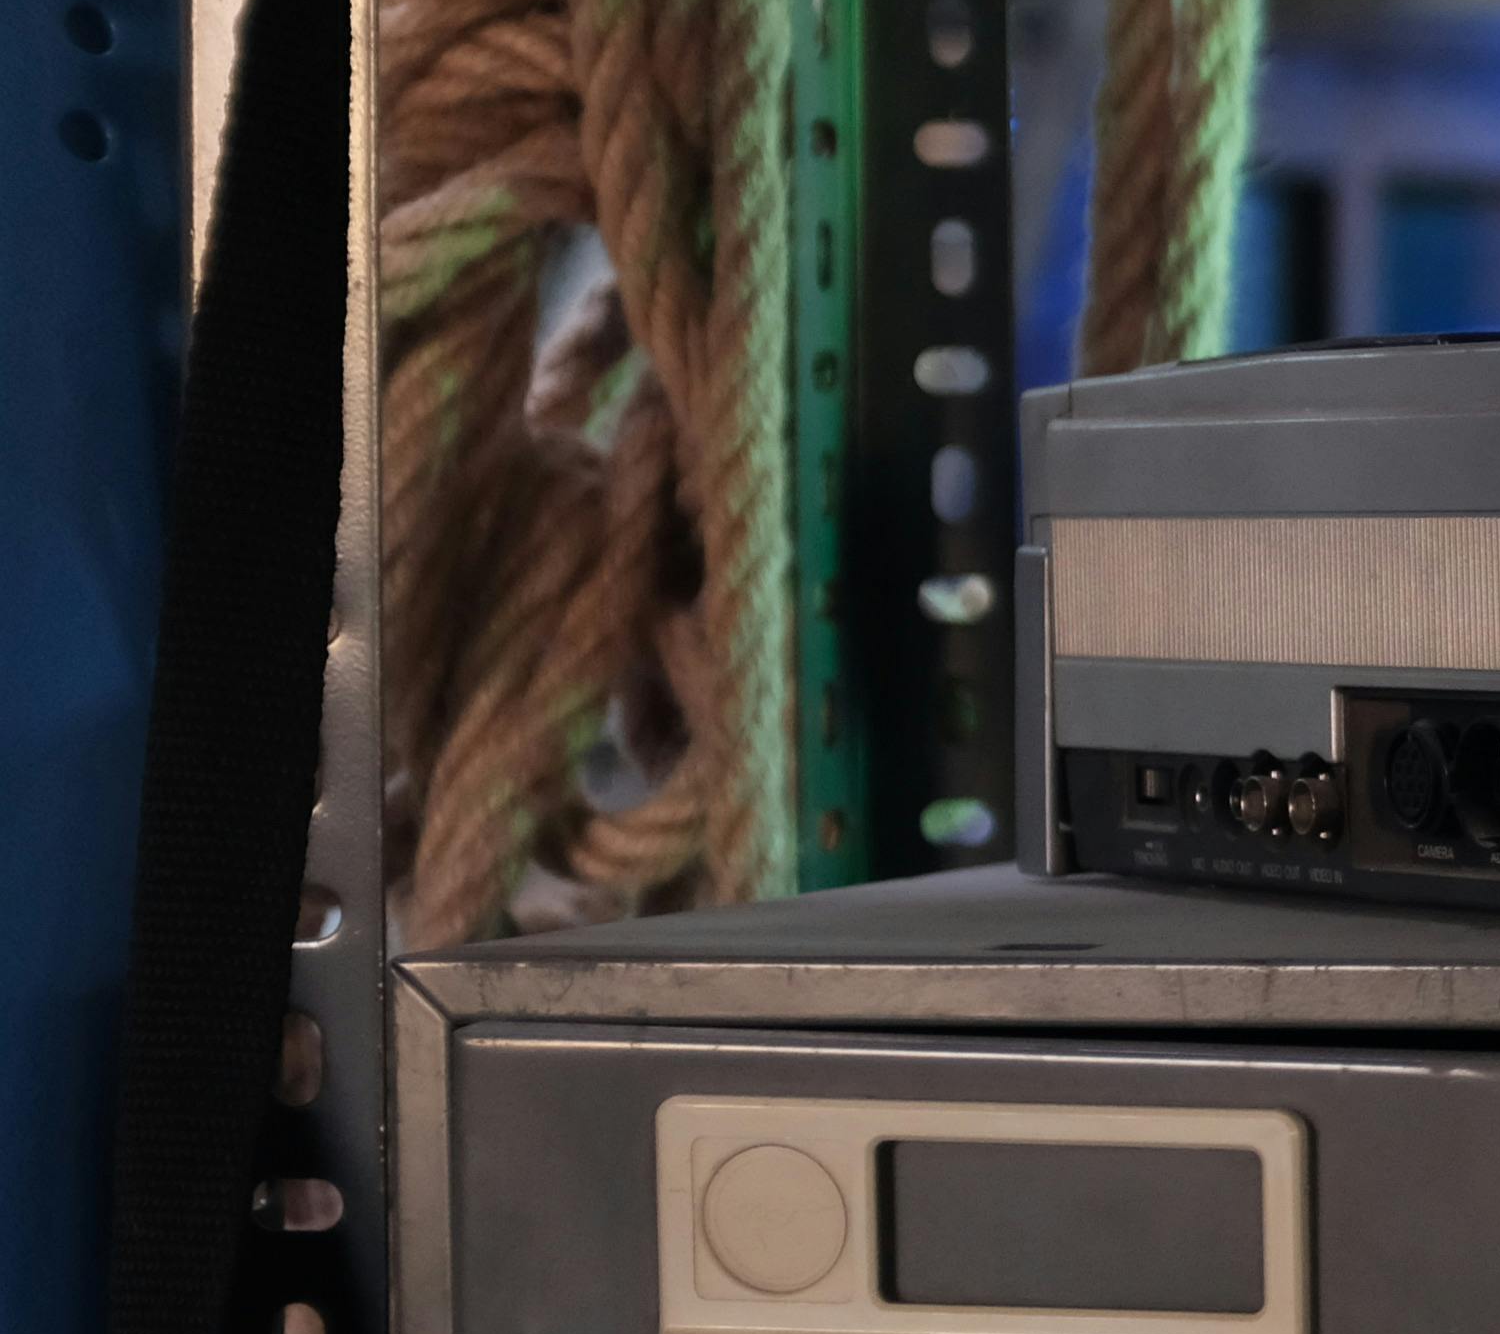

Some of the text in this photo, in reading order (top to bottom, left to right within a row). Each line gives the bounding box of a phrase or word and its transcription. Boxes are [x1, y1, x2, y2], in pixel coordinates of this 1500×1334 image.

[1416, 843, 1456, 860] CAMERA
[1261, 863, 1282, 879] VIDEO
[1308, 866, 1344, 885] VIDEO IN
